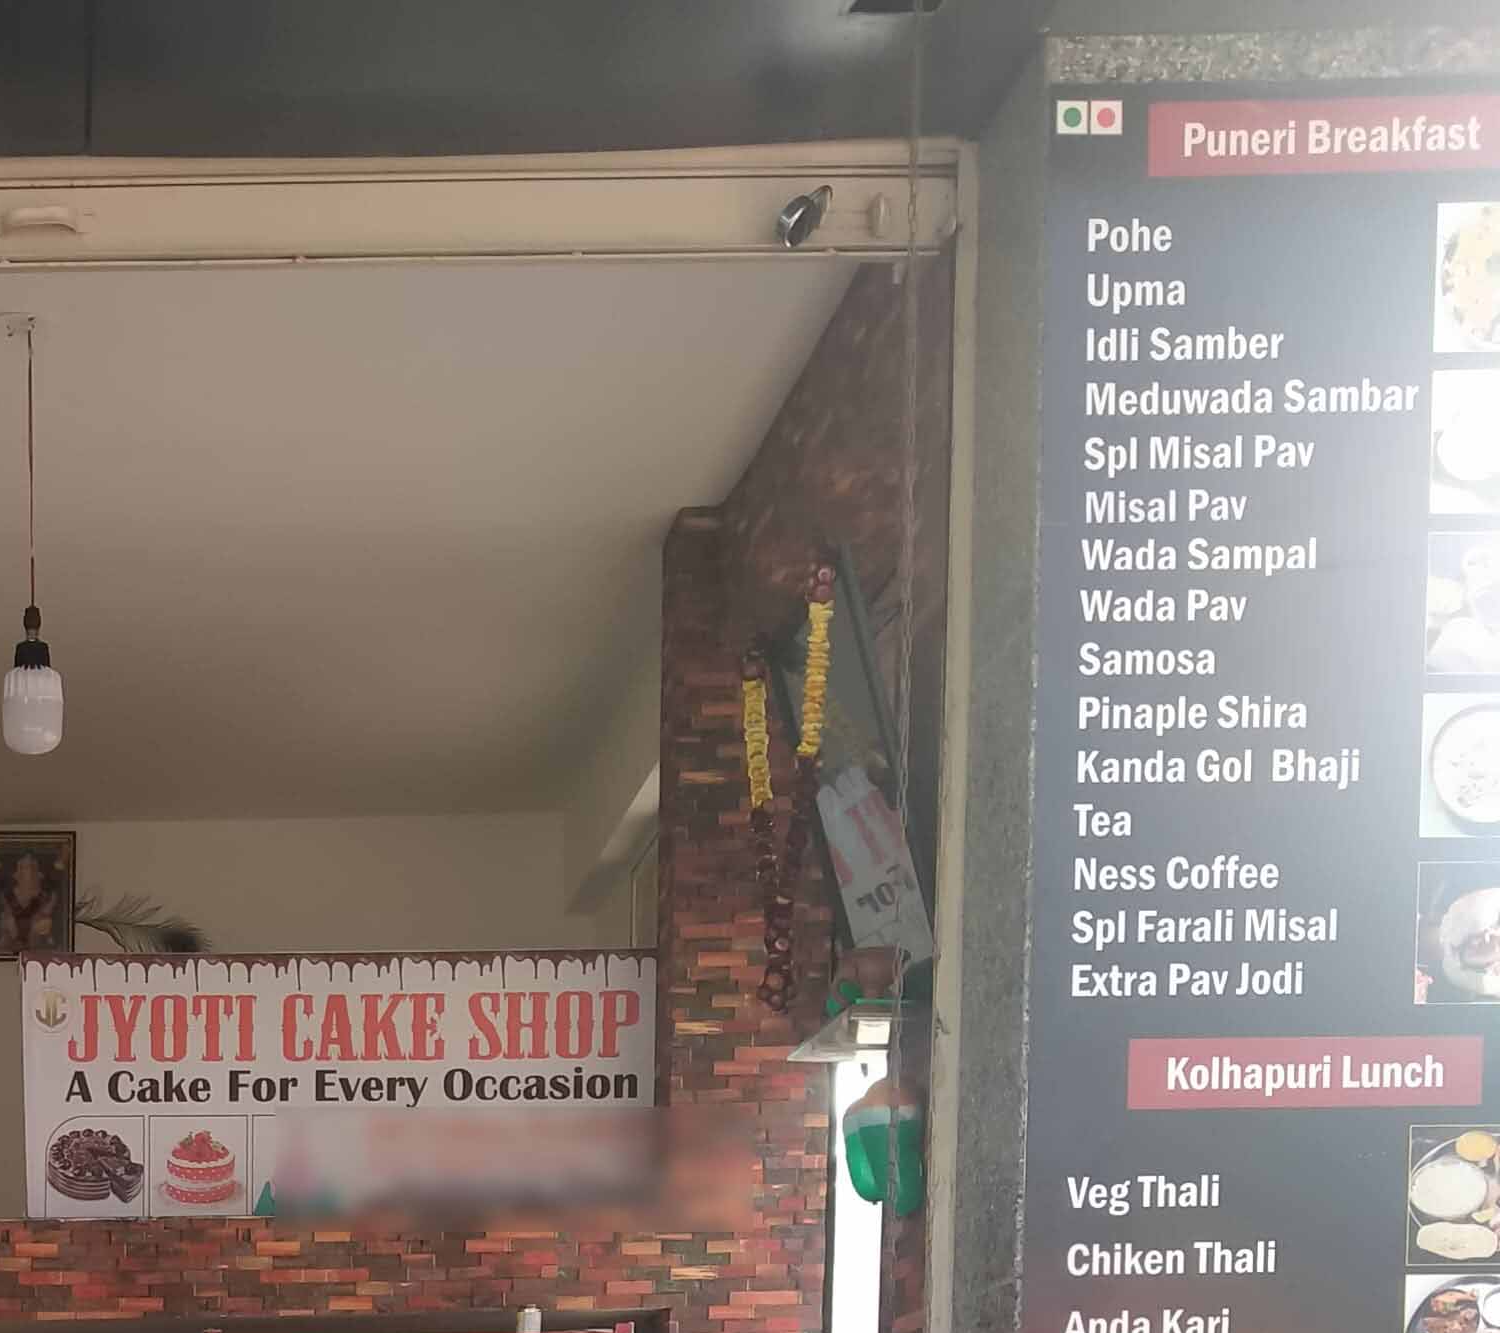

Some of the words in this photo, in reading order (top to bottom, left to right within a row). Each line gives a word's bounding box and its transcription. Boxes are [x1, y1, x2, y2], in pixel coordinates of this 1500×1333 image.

[1183, 120, 1296, 157] Puneri
[1308, 115, 1482, 155] Breakfast
[1086, 217, 1173, 252] Pohe
[1086, 273, 1186, 314] Upma
[1084, 327, 1140, 361] Idli
[1149, 326, 1284, 361] Samber
[1084, 381, 1273, 416] Meduwada
[1283, 378, 1419, 414] Sambar
[1083, 437, 1138, 478] Spl
[1148, 435, 1243, 470] Misal
[1253, 434, 1316, 469] Pav
[1084, 490, 1176, 525] Misal
[1188, 488, 1248, 522] Pav
[1081, 538, 1177, 572] Wada
[1187, 537, 1317, 577] Sampal
[1080, 589, 1176, 622] Wada
[1186, 589, 1248, 622] Pav
[1078, 642, 1216, 676] Samosa
[1078, 696, 1208, 736] Pinaple
[1217, 695, 1308, 730] Shira
[1076, 750, 1186, 784] Kanda
[1196, 749, 1253, 783] Gol
[1271, 748, 1362, 790] Bhaji
[1073, 803, 1133, 838] Tea
[1073, 857, 1156, 891] Ness
[1166, 855, 1280, 890] Coffee
[1071, 910, 1126, 951] Spl
[1136, 908, 1235, 943] Farali
[1243, 908, 1339, 942] Misal
[1070, 963, 1158, 998] Extra
[1168, 962, 1229, 997] Pav
[1235, 961, 1305, 996] Jodi
[67, 993, 258, 1063] JYOTI
[281, 992, 446, 1062] CAKE
[467, 989, 640, 1060] SHOP
[65, 1070, 93, 1104] A
[107, 1070, 212, 1104] Cake
[228, 1069, 299, 1103] For
[315, 1068, 429, 1108] Every
[442, 1066, 639, 1102] Occasion
[1166, 1056, 1332, 1097] Kolhapuri
[1341, 1055, 1444, 1089] Lunch
[1066, 1176, 1130, 1216] Veg
[1137, 1174, 1221, 1208] Thali
[1066, 1242, 1185, 1277] Chiken
[1193, 1241, 1277, 1274] Thali
